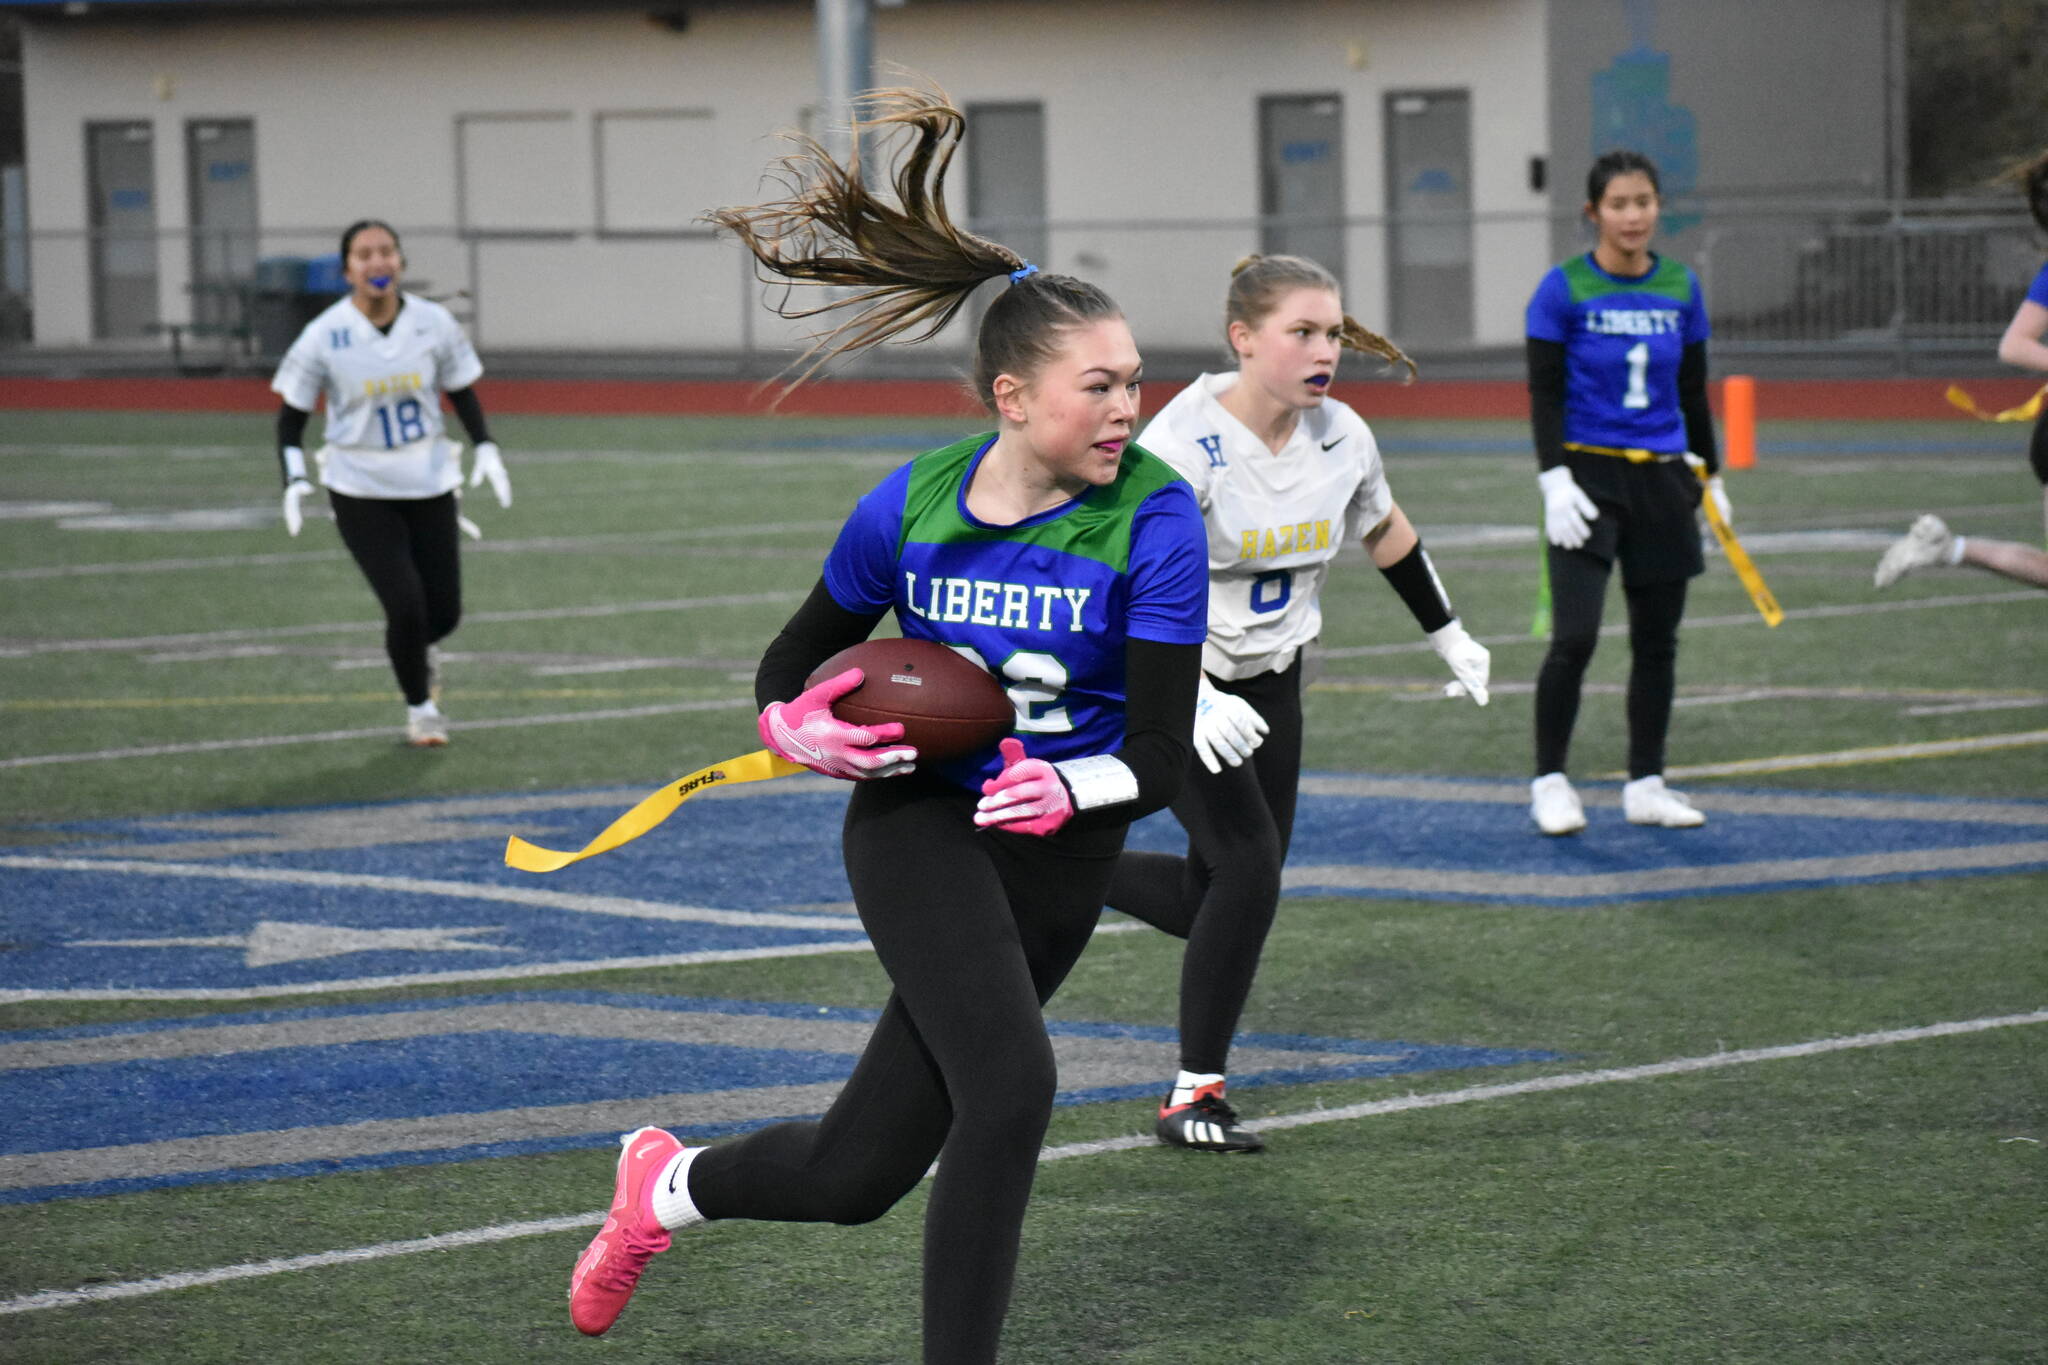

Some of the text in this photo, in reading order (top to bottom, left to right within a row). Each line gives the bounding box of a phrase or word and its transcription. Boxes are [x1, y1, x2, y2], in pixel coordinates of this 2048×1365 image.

[1586, 309, 1680, 335] LIBERTY
[1623, 342, 1650, 409] 1
[377, 397, 425, 449] 18
[1196, 434, 1228, 468] H
[1239, 519, 1332, 560] HAZEN
[905, 571, 1091, 632] LIBERTY
[942, 643, 1075, 734] 2
